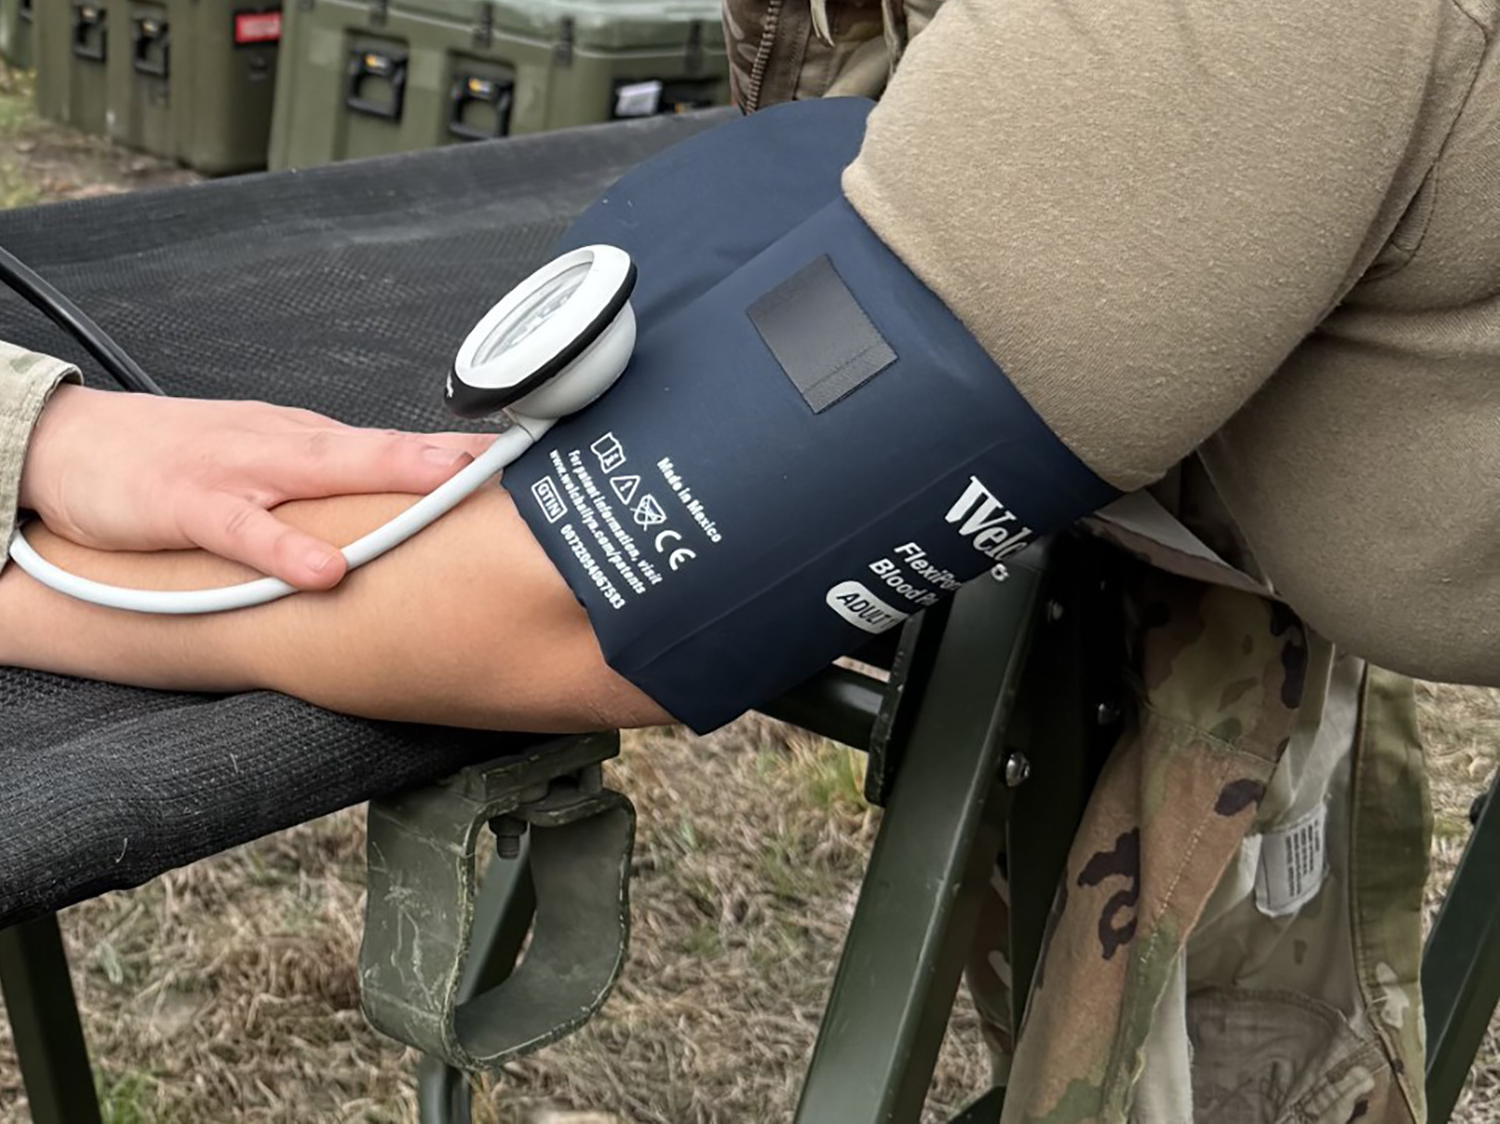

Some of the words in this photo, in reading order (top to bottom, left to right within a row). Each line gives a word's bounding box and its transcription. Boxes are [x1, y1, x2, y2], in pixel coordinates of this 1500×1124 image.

[568, 449, 583, 466] For
[572, 465, 601, 499] patent
[536, 483, 562, 517] GTIN
[657, 456, 683, 491] Made
[678, 488, 692, 504] in
[686, 499, 722, 543] Mexico
[593, 496, 640, 561] information,
[637, 559, 663, 585] visit
[868, 558, 927, 604] Blood
[836, 592, 892, 625] ADULT
